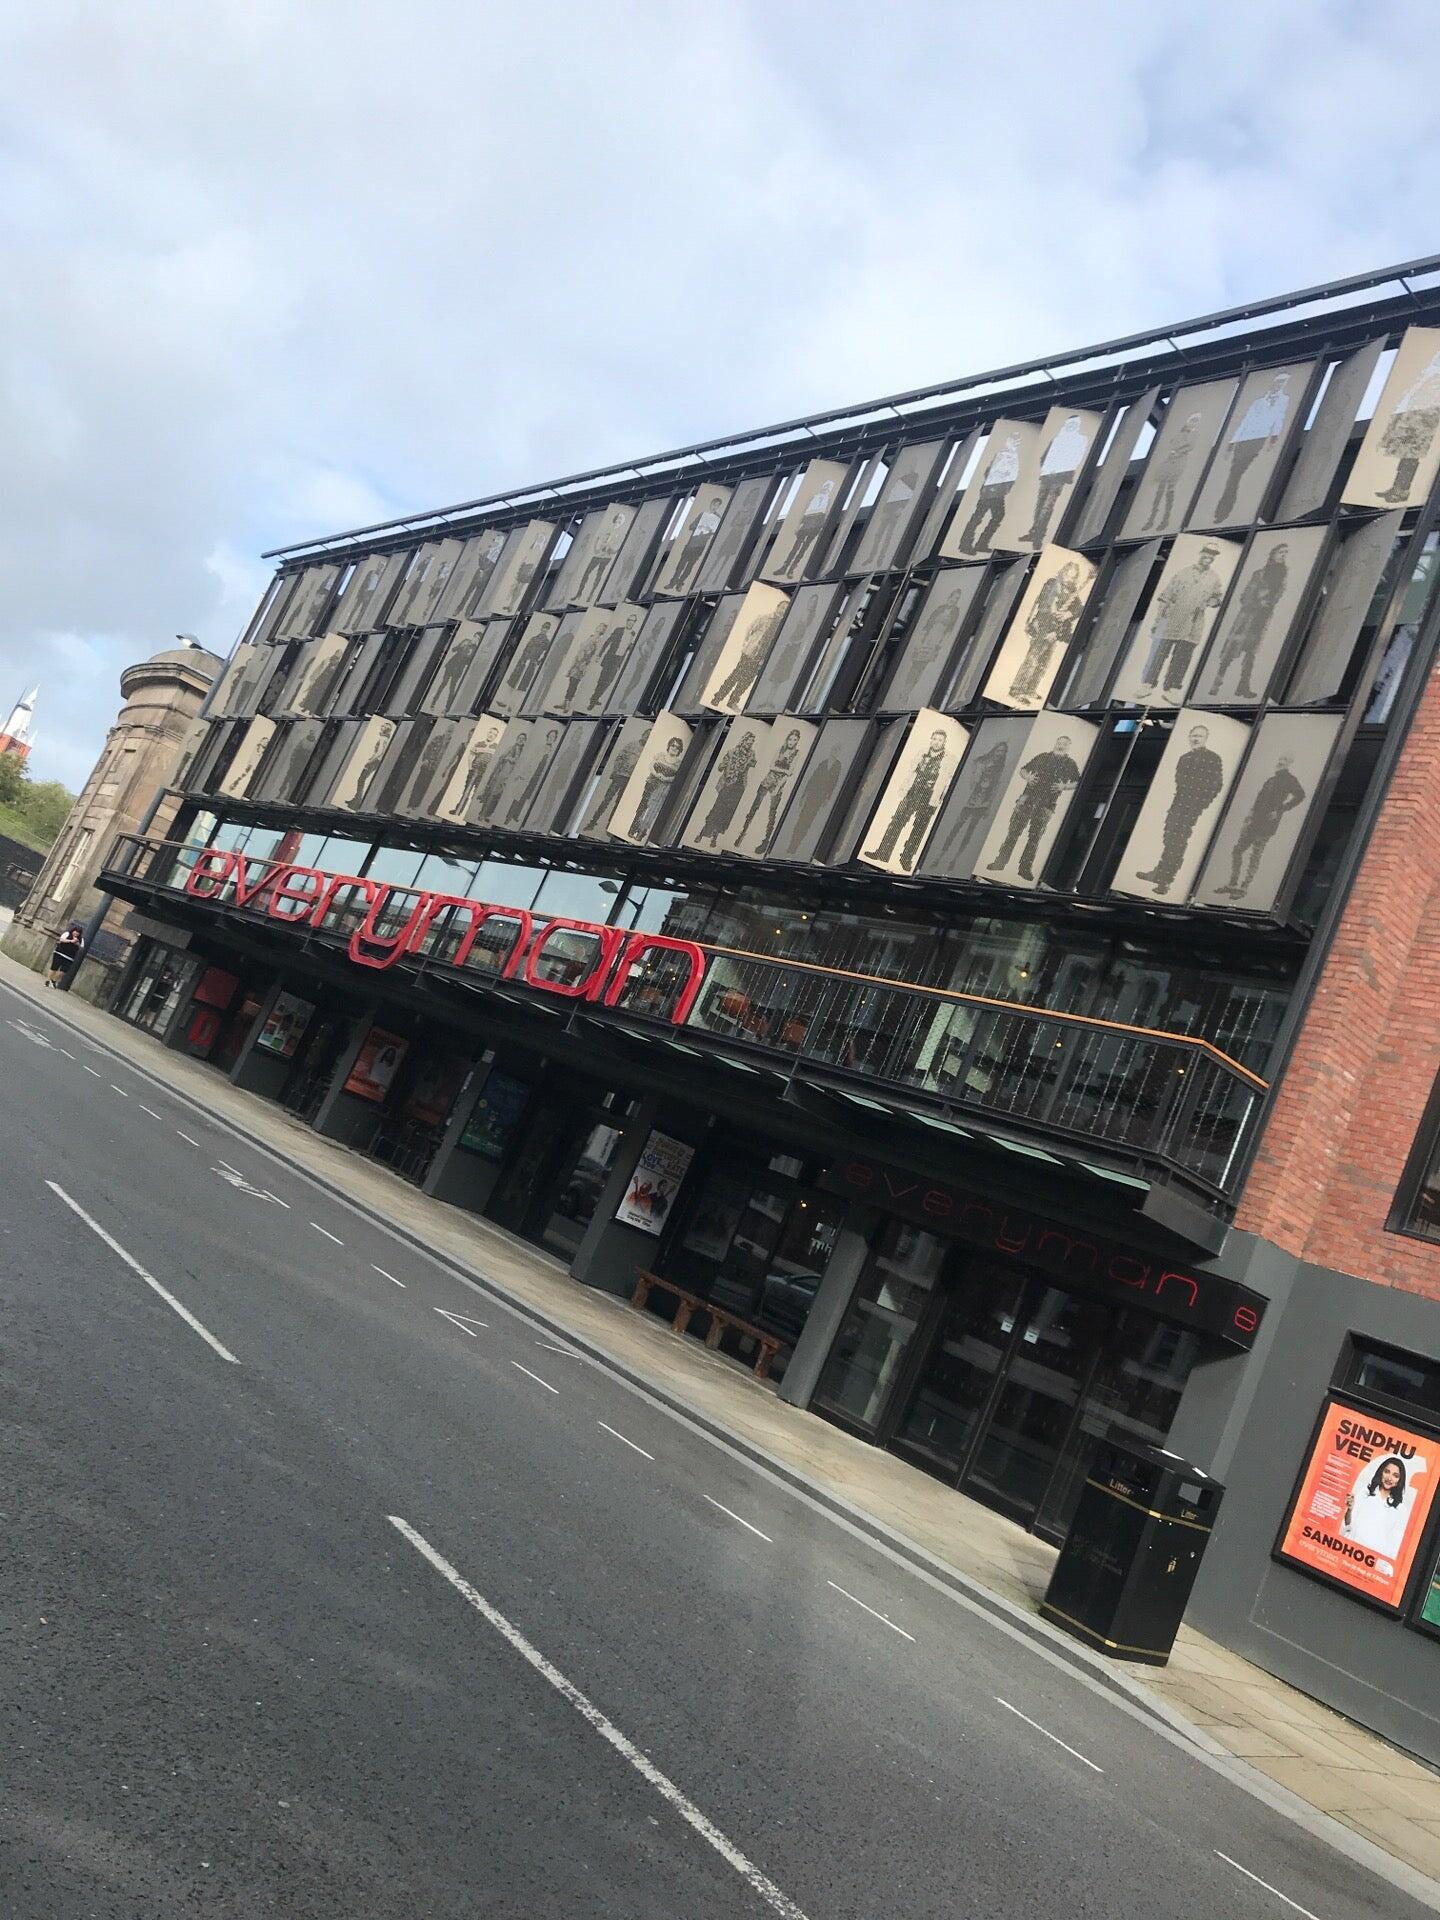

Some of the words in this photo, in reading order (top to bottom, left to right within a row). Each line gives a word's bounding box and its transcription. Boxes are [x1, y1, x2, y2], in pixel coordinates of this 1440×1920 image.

[186, 849, 706, 1025] everyman
[845, 1163, 1198, 1307] everyman
[1336, 1437, 1373, 1462] VEE
[1338, 1420, 1416, 1460] SINDHU
[1109, 1479, 1132, 1495] Litter
[1302, 1526, 1375, 1567] SANDHOG
